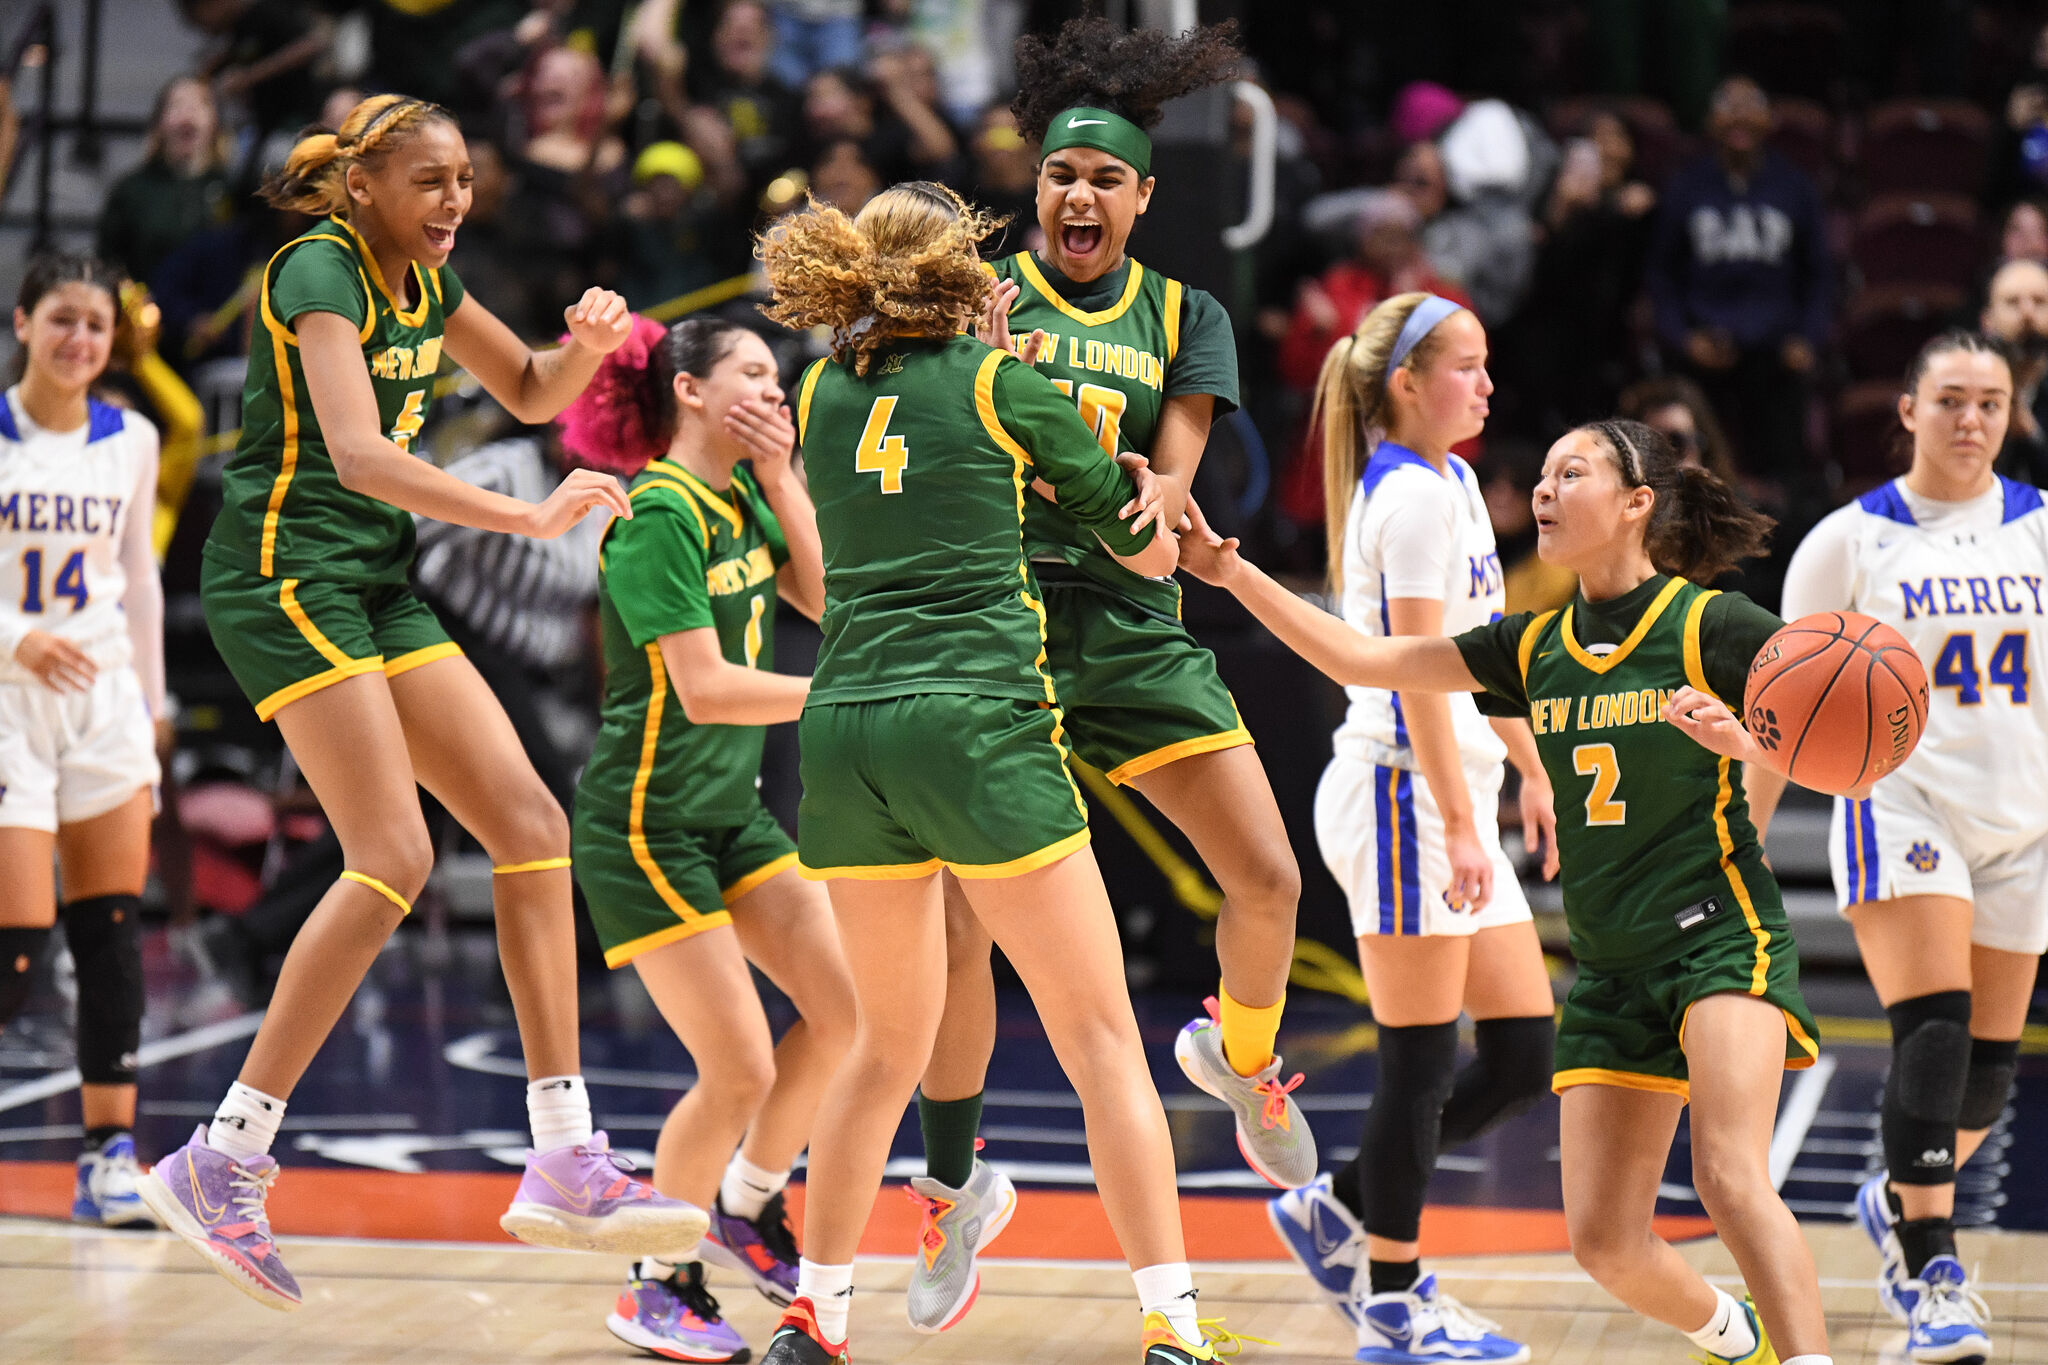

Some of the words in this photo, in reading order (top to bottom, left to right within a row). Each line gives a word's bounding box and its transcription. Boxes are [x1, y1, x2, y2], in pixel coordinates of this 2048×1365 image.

[1010, 332, 1060, 363] EW
[1069, 336, 1164, 393] LONDON
[391, 389, 425, 454] 5
[855, 395, 909, 495] 4
[0, 492, 122, 536] MERCY
[19, 546, 91, 616] 14
[1898, 574, 2044, 620] MERCY
[1931, 630, 2031, 707] 44
[1531, 697, 1572, 735] NEW
[1577, 688, 1676, 731] LONDON
[1887, 703, 1910, 766] DING
[1572, 742, 1627, 827] 2
[1707, 902, 1717, 912] S
